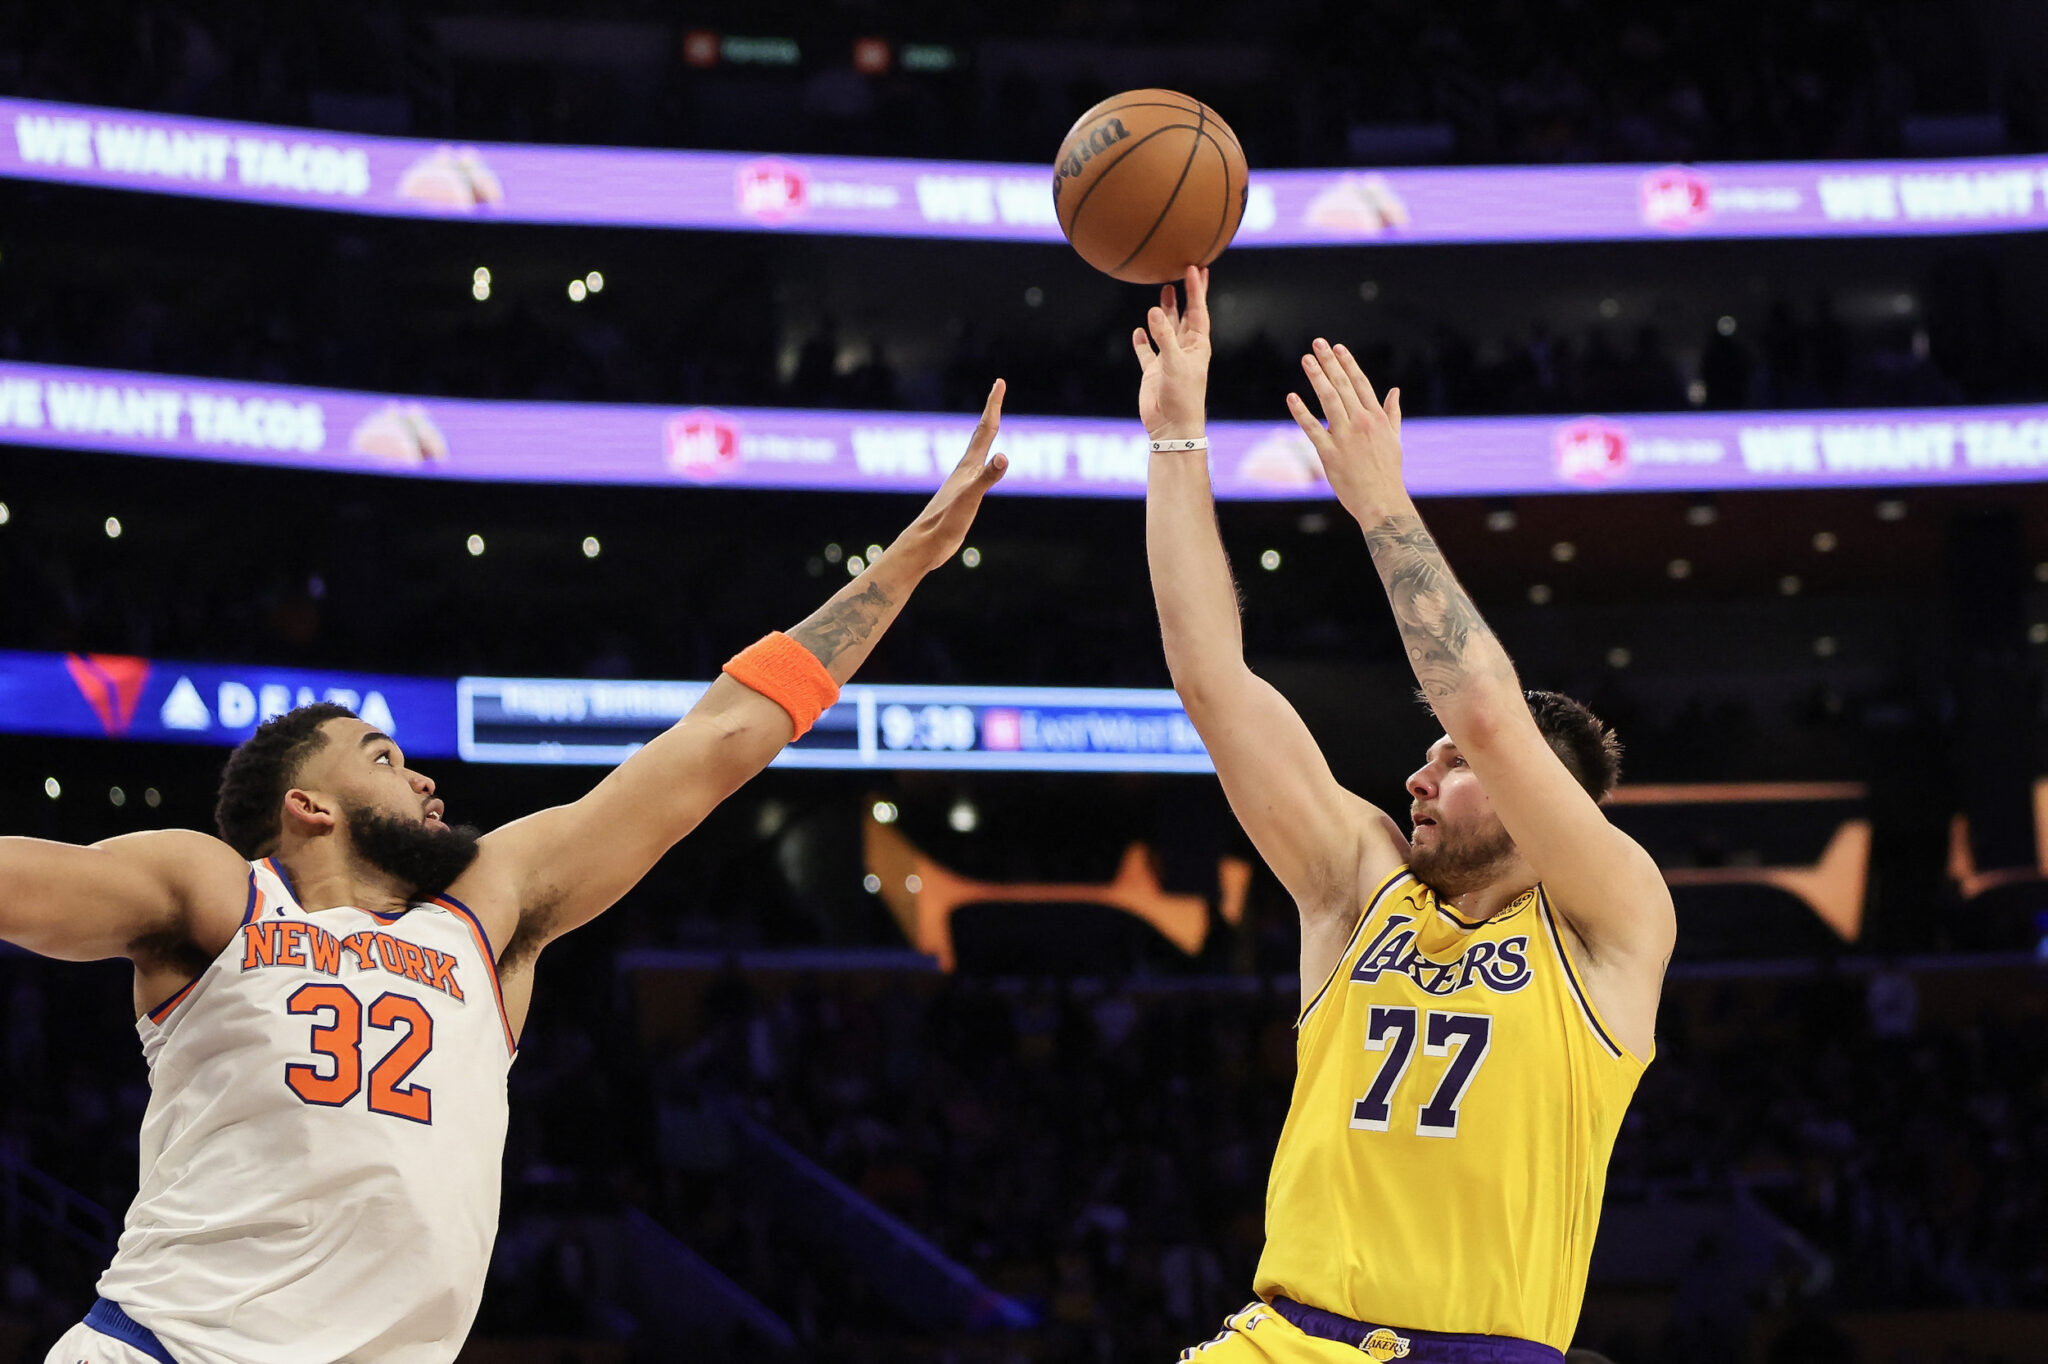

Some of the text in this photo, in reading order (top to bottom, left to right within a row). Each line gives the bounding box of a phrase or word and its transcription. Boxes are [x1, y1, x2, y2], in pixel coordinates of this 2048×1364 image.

[16, 115, 370, 197] WE WANT TACOS
[915, 173, 993, 223] WE
[1818, 174, 1897, 220] WE
[1899, 169, 2034, 219] WANT
[0, 377, 325, 452] E WANT TACOS
[852, 427, 932, 476] WE
[1738, 426, 1817, 473] WE
[1820, 422, 1954, 471] WANT
[241, 921, 465, 1005] NEW YORK
[1349, 913, 1534, 996] LAKERS
[285, 982, 433, 1126] 32
[1348, 1004, 1494, 1139] 77
[1362, 1334, 1409, 1356] LAKERS
